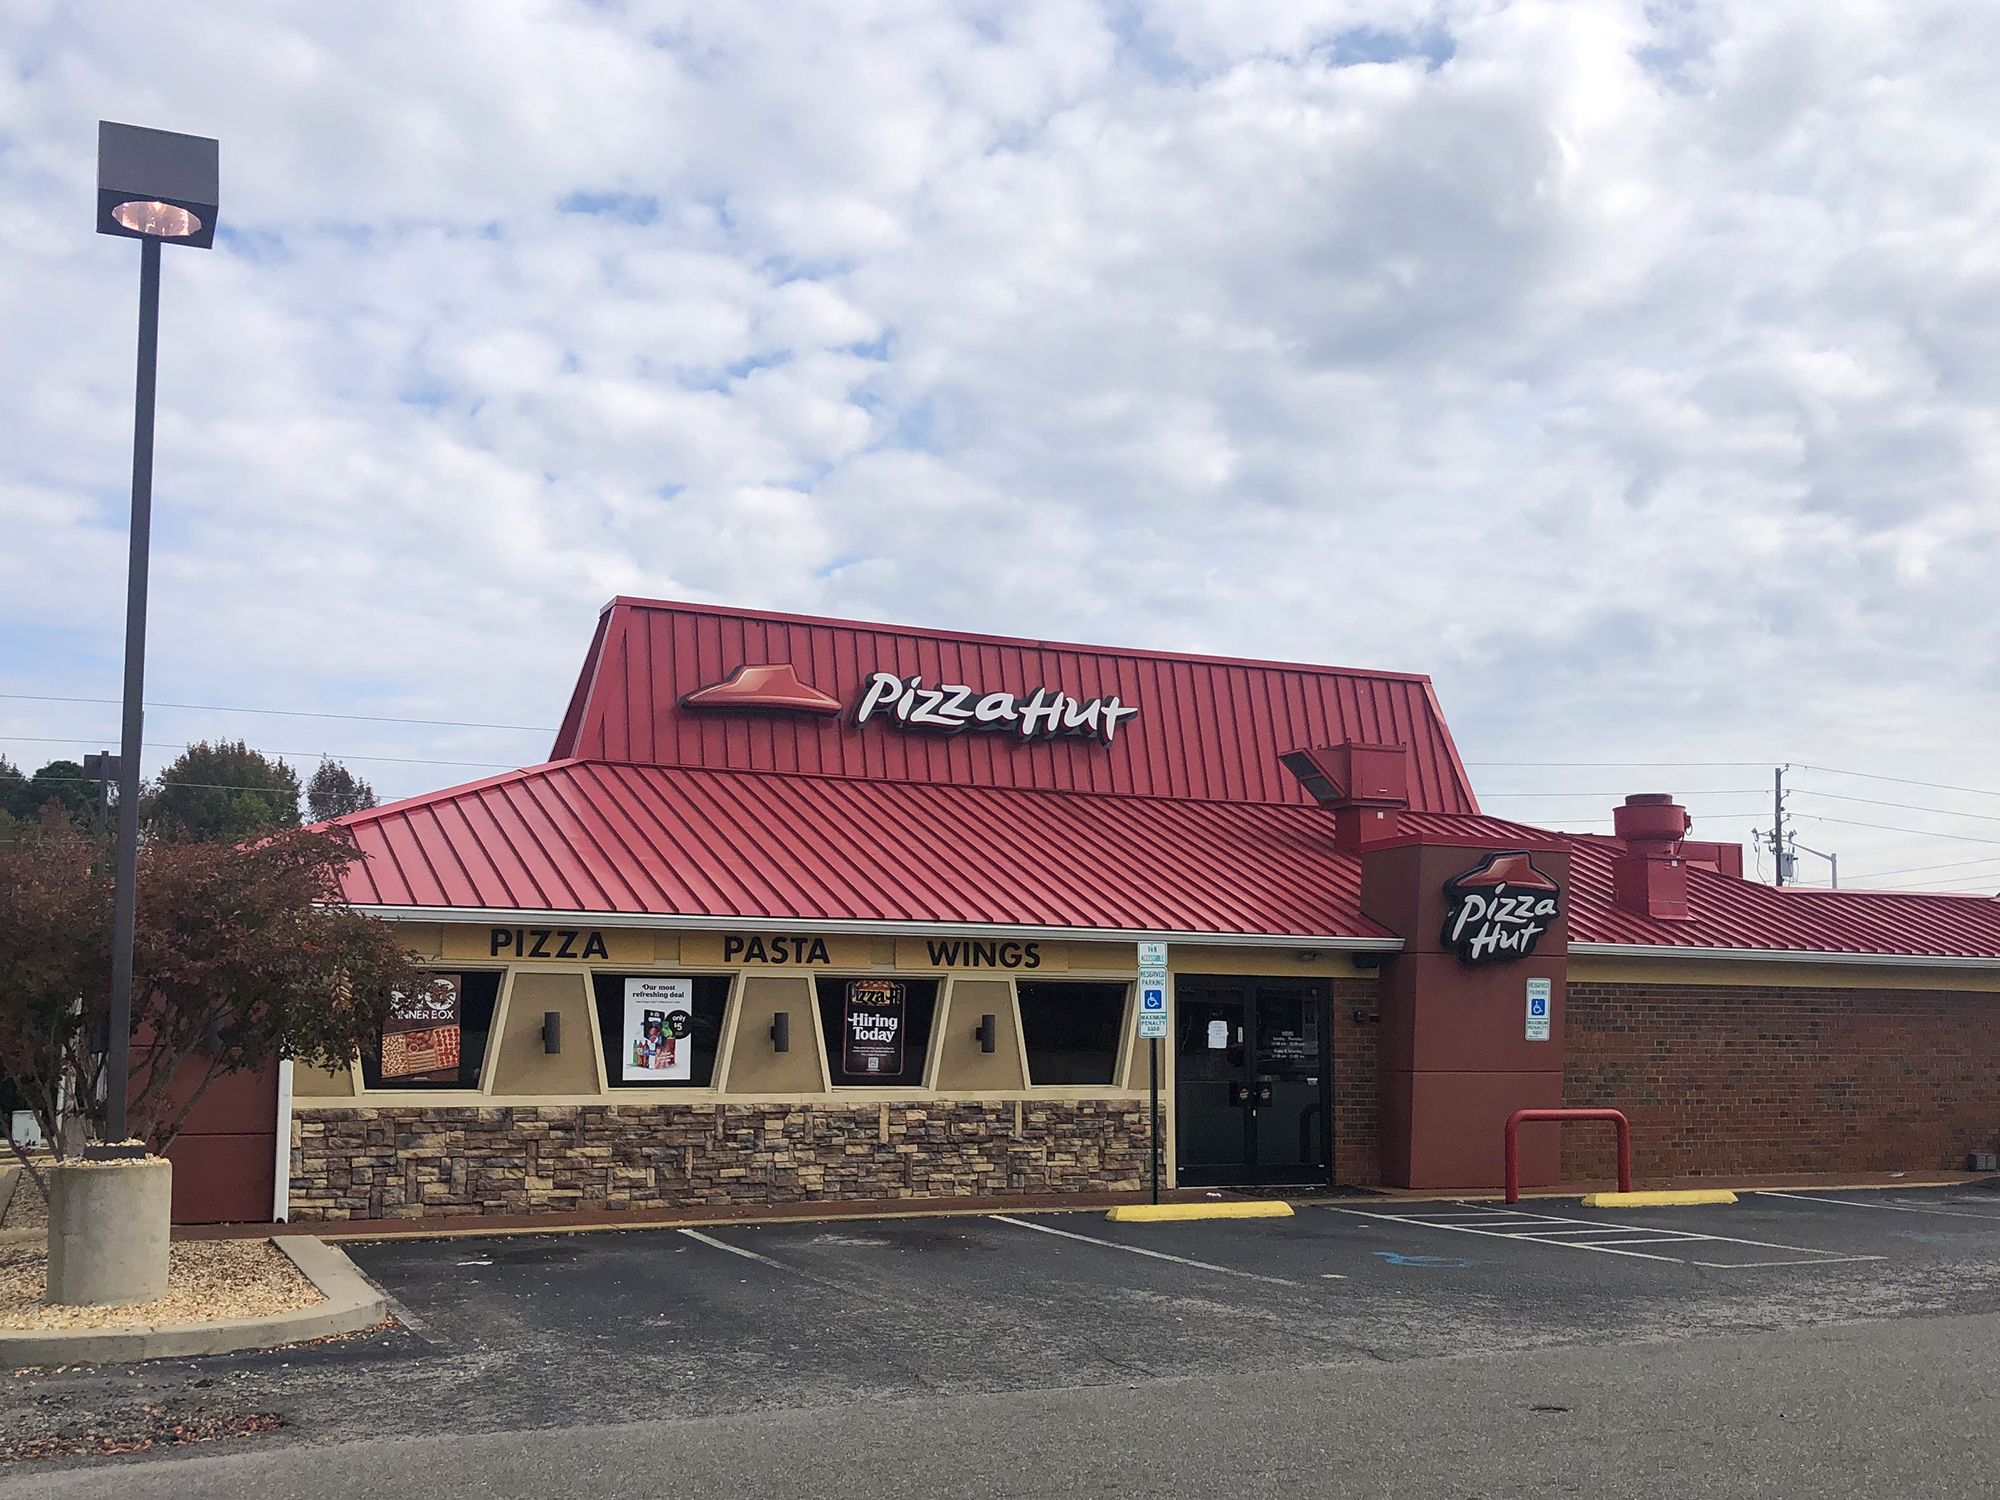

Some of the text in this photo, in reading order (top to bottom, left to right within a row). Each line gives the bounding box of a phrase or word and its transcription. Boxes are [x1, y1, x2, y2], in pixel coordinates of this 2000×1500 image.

[858, 672, 1138, 741] Pizza Hut
[1452, 883, 1556, 941] Pizza
[490, 928, 609, 960] PIZZA
[724, 935, 830, 964] PASTA
[927, 940, 1041, 969] WINGS
[1470, 923, 1544, 960] Hut
[672, 1014, 686, 1023] only
[673, 1022, 683, 1031] $5
[847, 1013, 898, 1030] Hiring
[852, 1027, 895, 1043] Today
